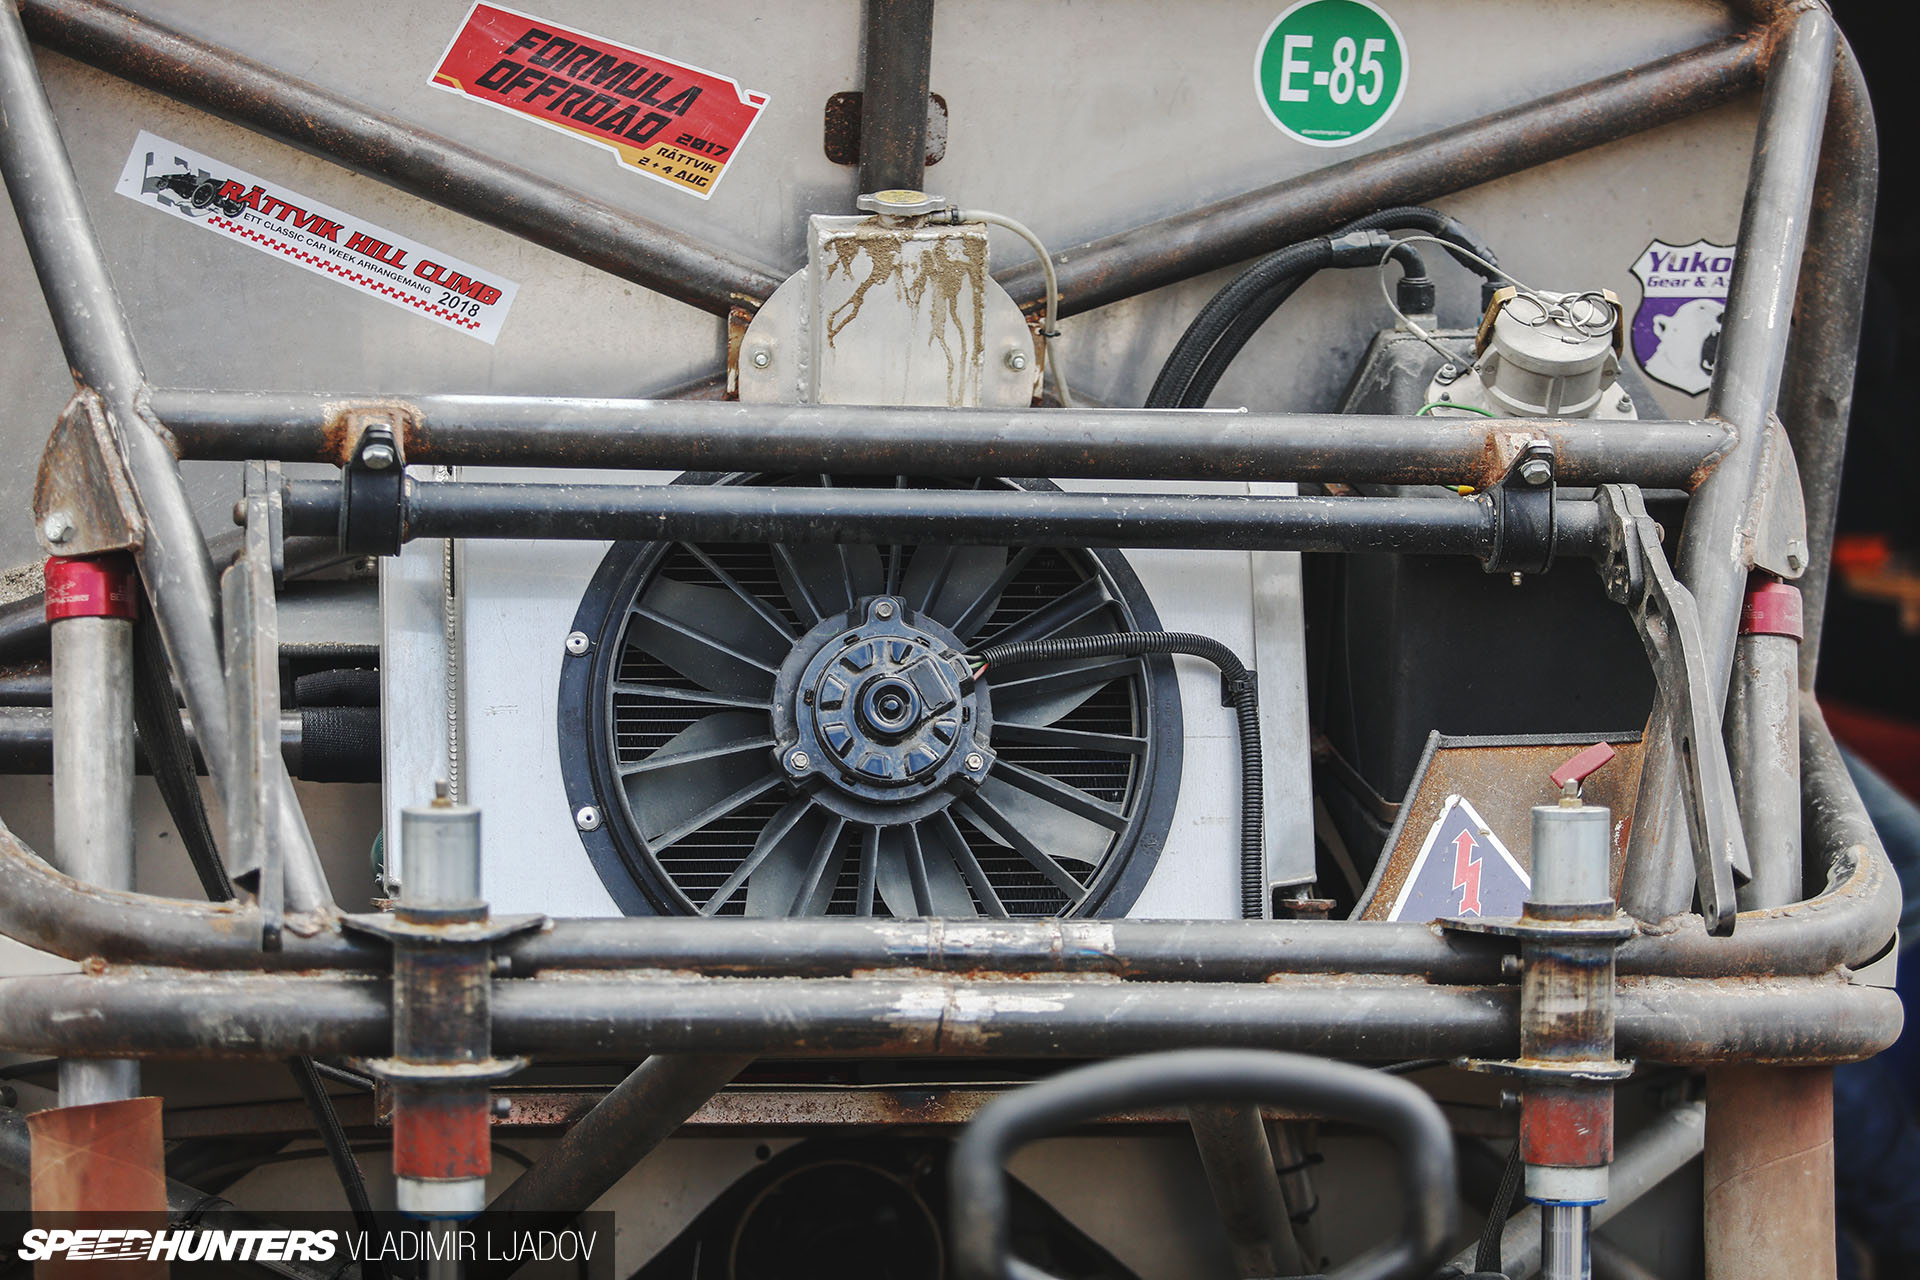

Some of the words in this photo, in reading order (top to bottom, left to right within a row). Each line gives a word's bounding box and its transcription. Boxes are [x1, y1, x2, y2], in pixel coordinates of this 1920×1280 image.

[503, 28, 703, 117] FORMULA
[1279, 34, 1386, 106] E-85
[475, 60, 673, 144] OFFROAD
[656, 147, 717, 173] RÄTTVIK
[675, 133, 729, 156] 2017
[638, 156, 650, 166] 2
[662, 165, 673, 174] 4
[674, 169, 709, 187] AUG
[218, 178, 345, 243] RÄTTVIK
[344, 231, 408, 270] HILL
[413, 259, 503, 306] CLIMB
[243, 212, 262, 225] ETT
[263, 220, 305, 243] CLASSIC
[306, 237, 327, 252] CAR
[328, 246, 356, 264] WEEK
[358, 258, 432, 295] ARRANGEMANG
[438, 291, 480, 317] 2018
[1647, 276, 1689, 287] Gear
[1694, 276, 1706, 287] &
[1711, 276, 1729, 287] A
